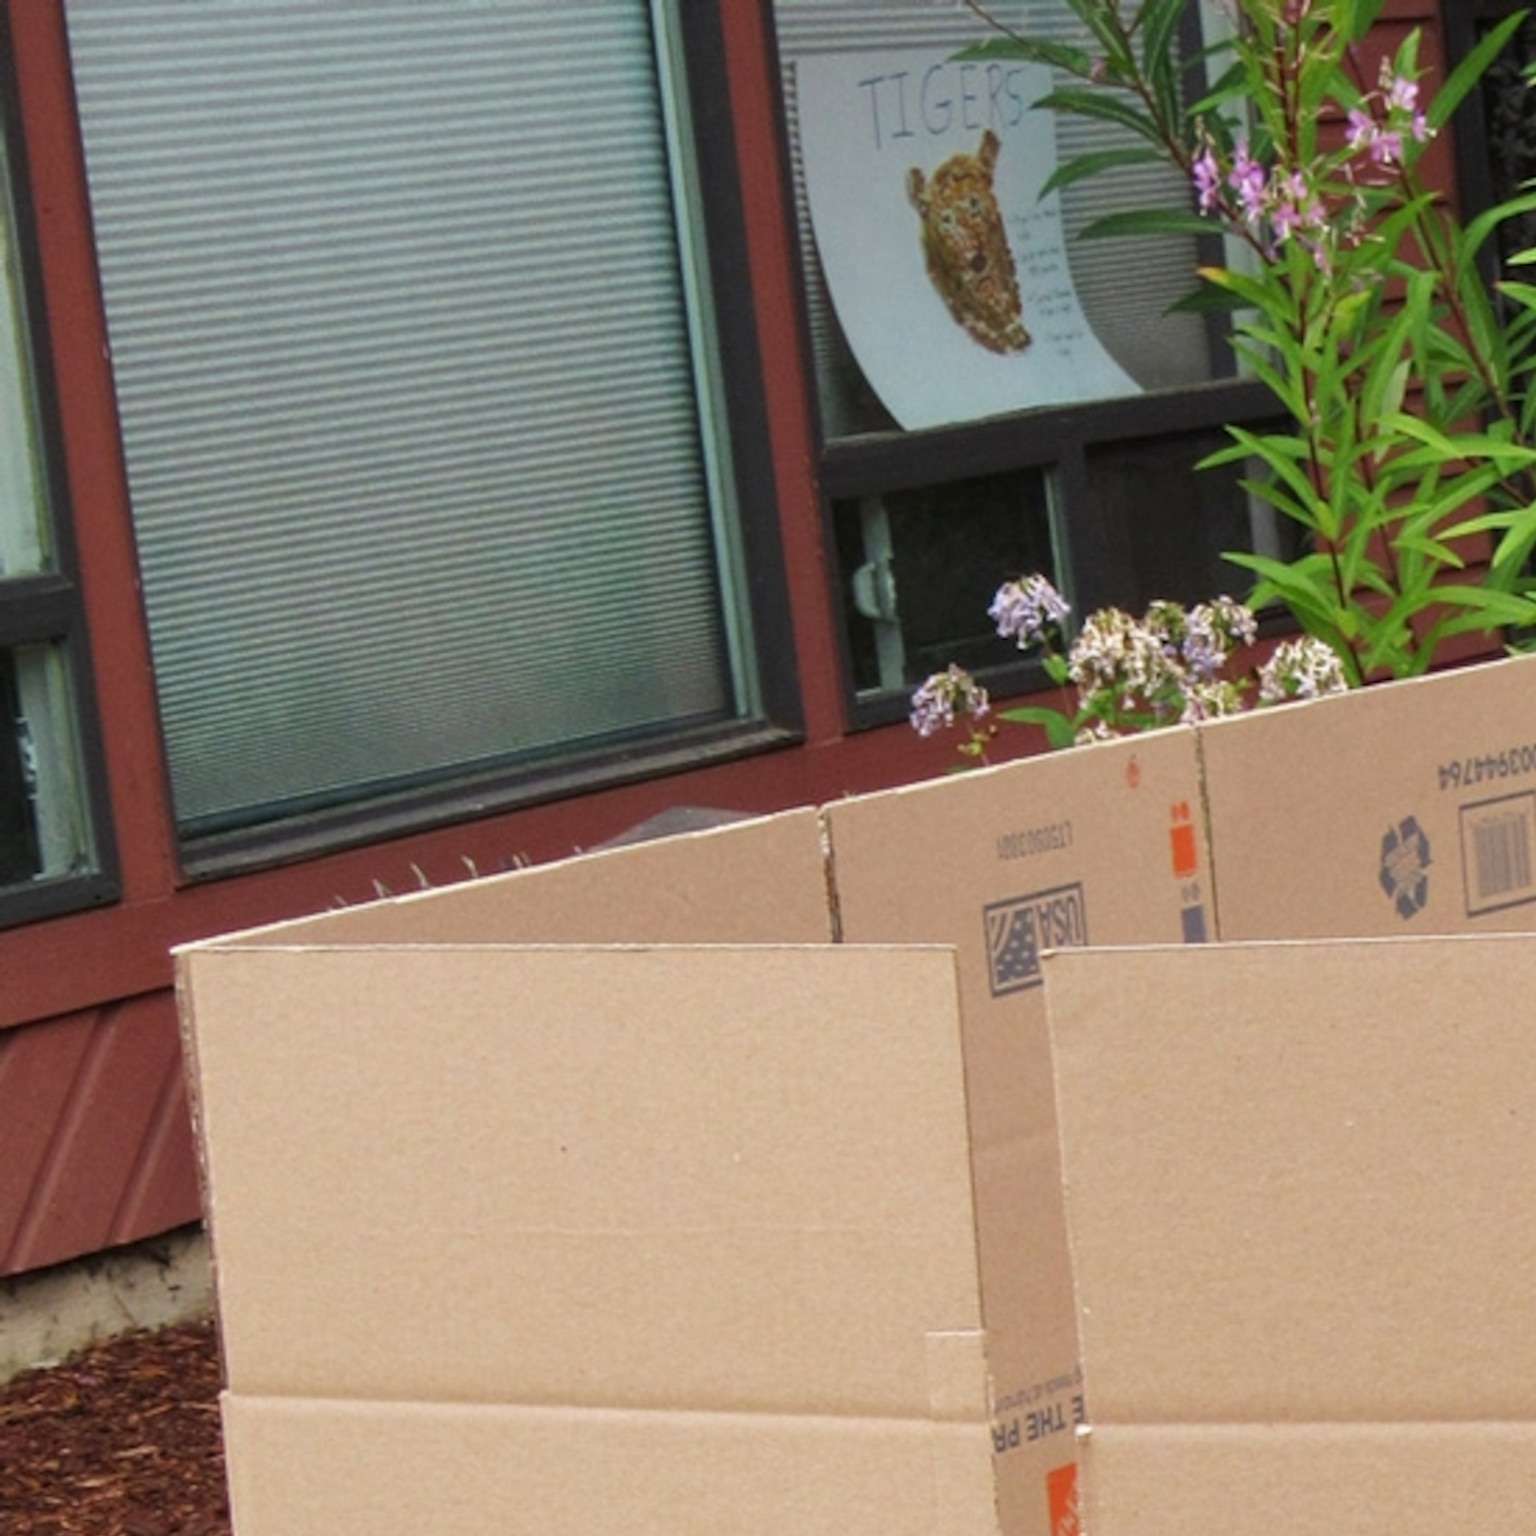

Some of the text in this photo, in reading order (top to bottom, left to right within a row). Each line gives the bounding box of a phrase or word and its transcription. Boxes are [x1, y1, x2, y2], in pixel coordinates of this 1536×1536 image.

[857, 62, 1024, 149] TIGERS
[1036, 894, 1083, 949] USA
[1026, 1403, 1067, 1441] THE
